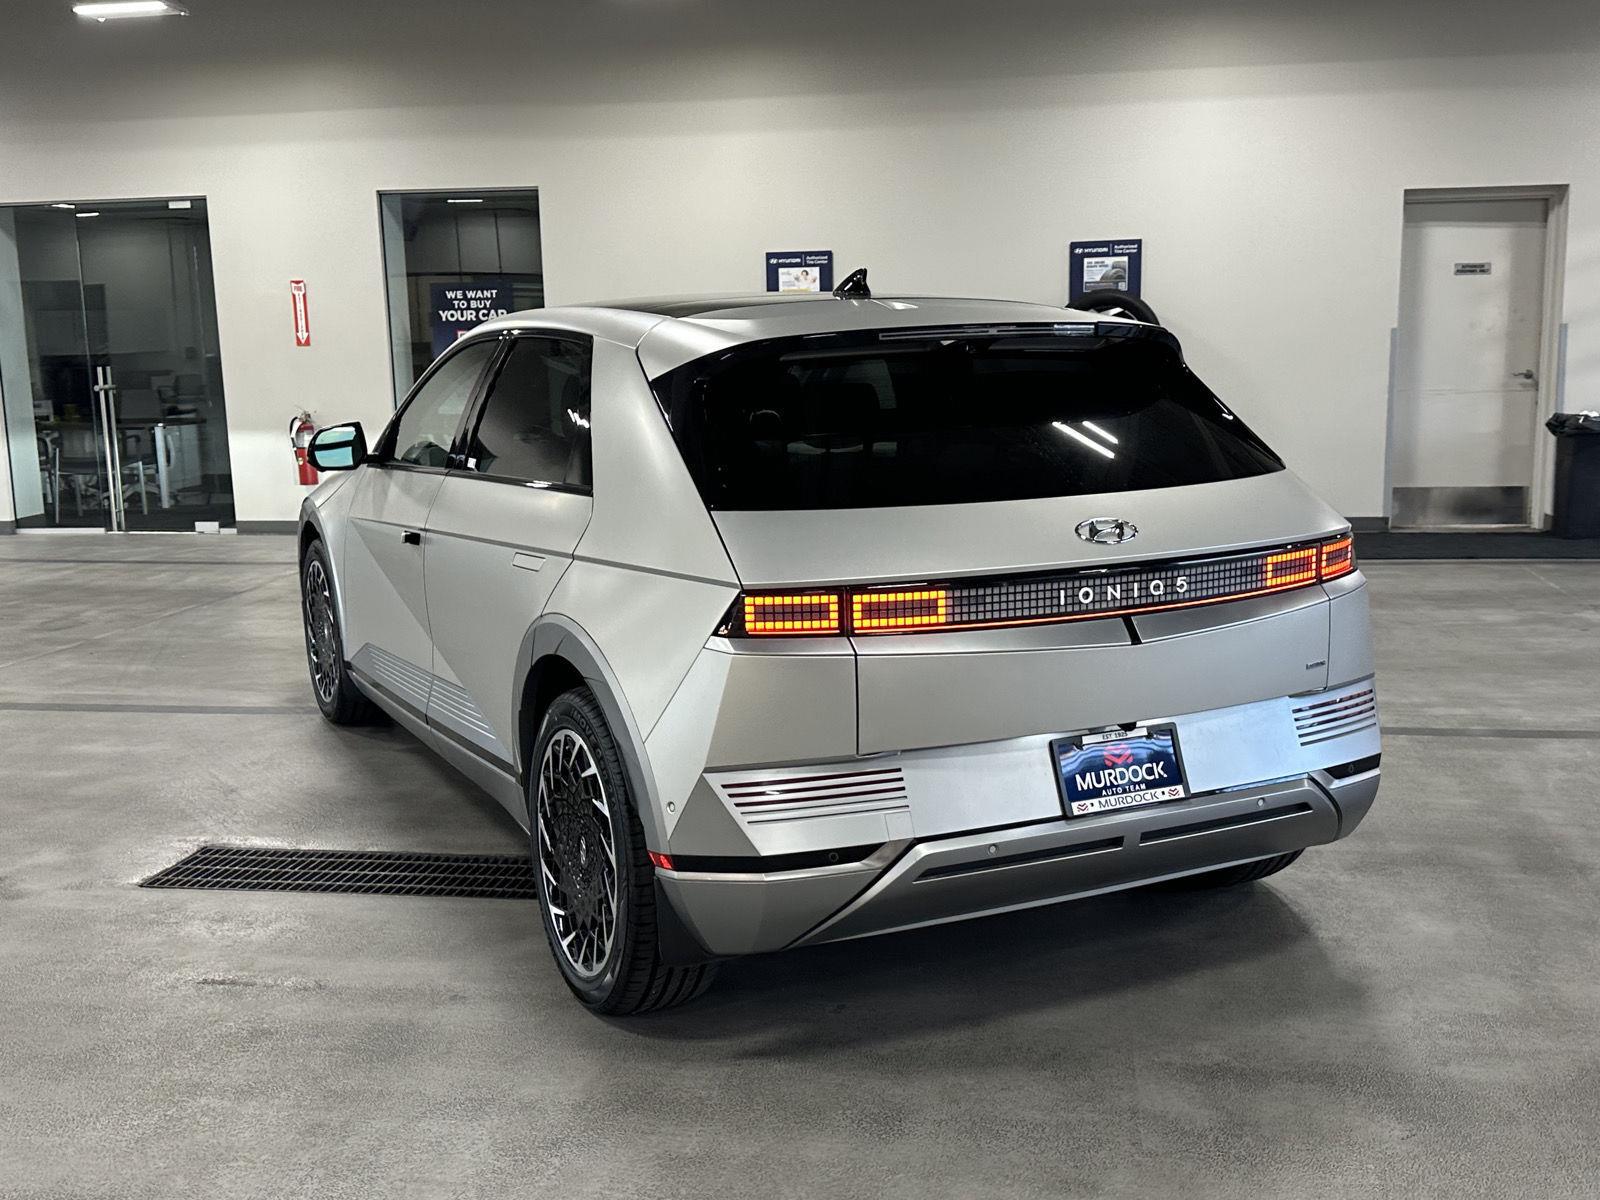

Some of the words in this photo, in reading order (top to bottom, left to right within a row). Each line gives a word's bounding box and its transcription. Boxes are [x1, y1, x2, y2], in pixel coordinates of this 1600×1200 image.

[445, 290, 463, 299] WE
[466, 289, 498, 298] WANT
[453, 300, 467, 309] TO
[470, 299, 492, 308] BUY
[439, 309, 476, 321] YOUR
[1060, 579, 1164, 605] IONIQ
[1176, 576, 1188, 593] 5
[1075, 761, 1168, 791] MURDOCK
[1102, 787, 1123, 796] AUTO
[1126, 783, 1147, 792] TEAM
[1098, 791, 1160, 809] MURDOCK
